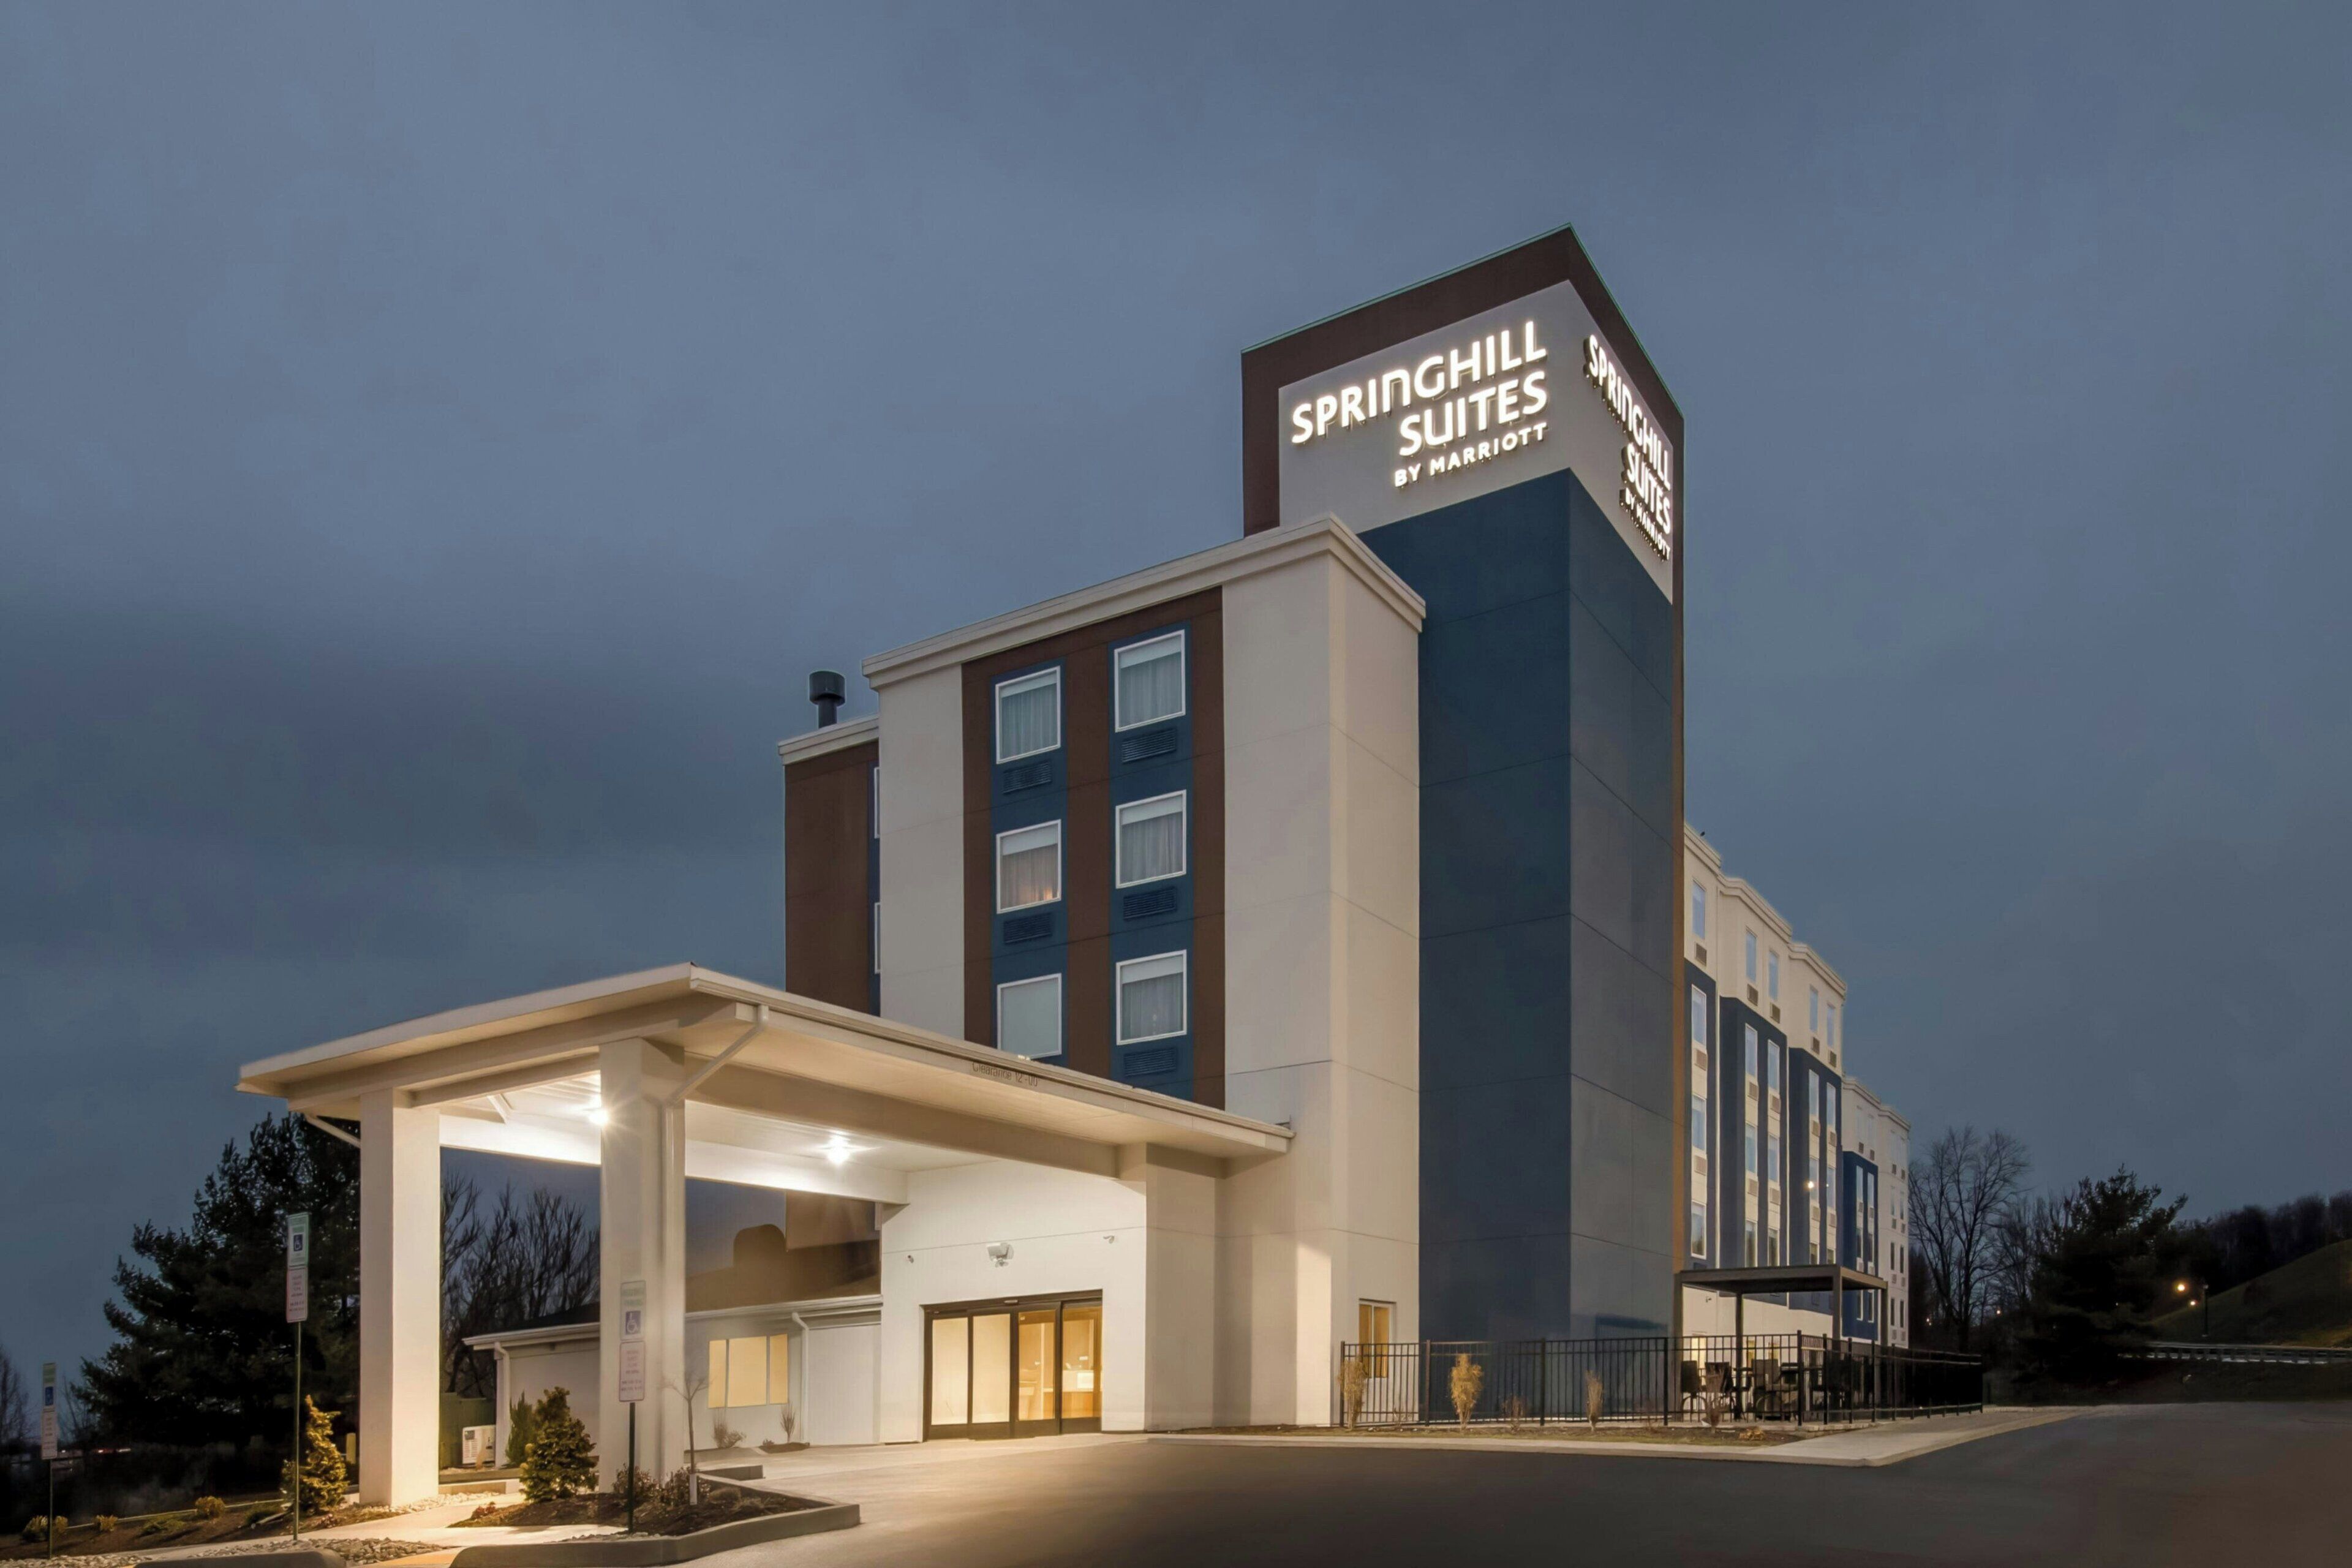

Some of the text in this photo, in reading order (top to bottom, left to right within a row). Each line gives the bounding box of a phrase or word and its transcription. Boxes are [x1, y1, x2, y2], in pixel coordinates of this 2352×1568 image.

[1292, 321, 1547, 443] SPRINGHILL
[1399, 371, 1547, 456] SUITES
[1589, 334, 1671, 491] SPRINGHILL
[1394, 422, 1547, 487] BY MARRIOTT
[1627, 443, 1671, 534] SUITES
[1625, 488, 1671, 560] BY MARRIOTT
[972, 1063, 1012, 1080] Clearance
